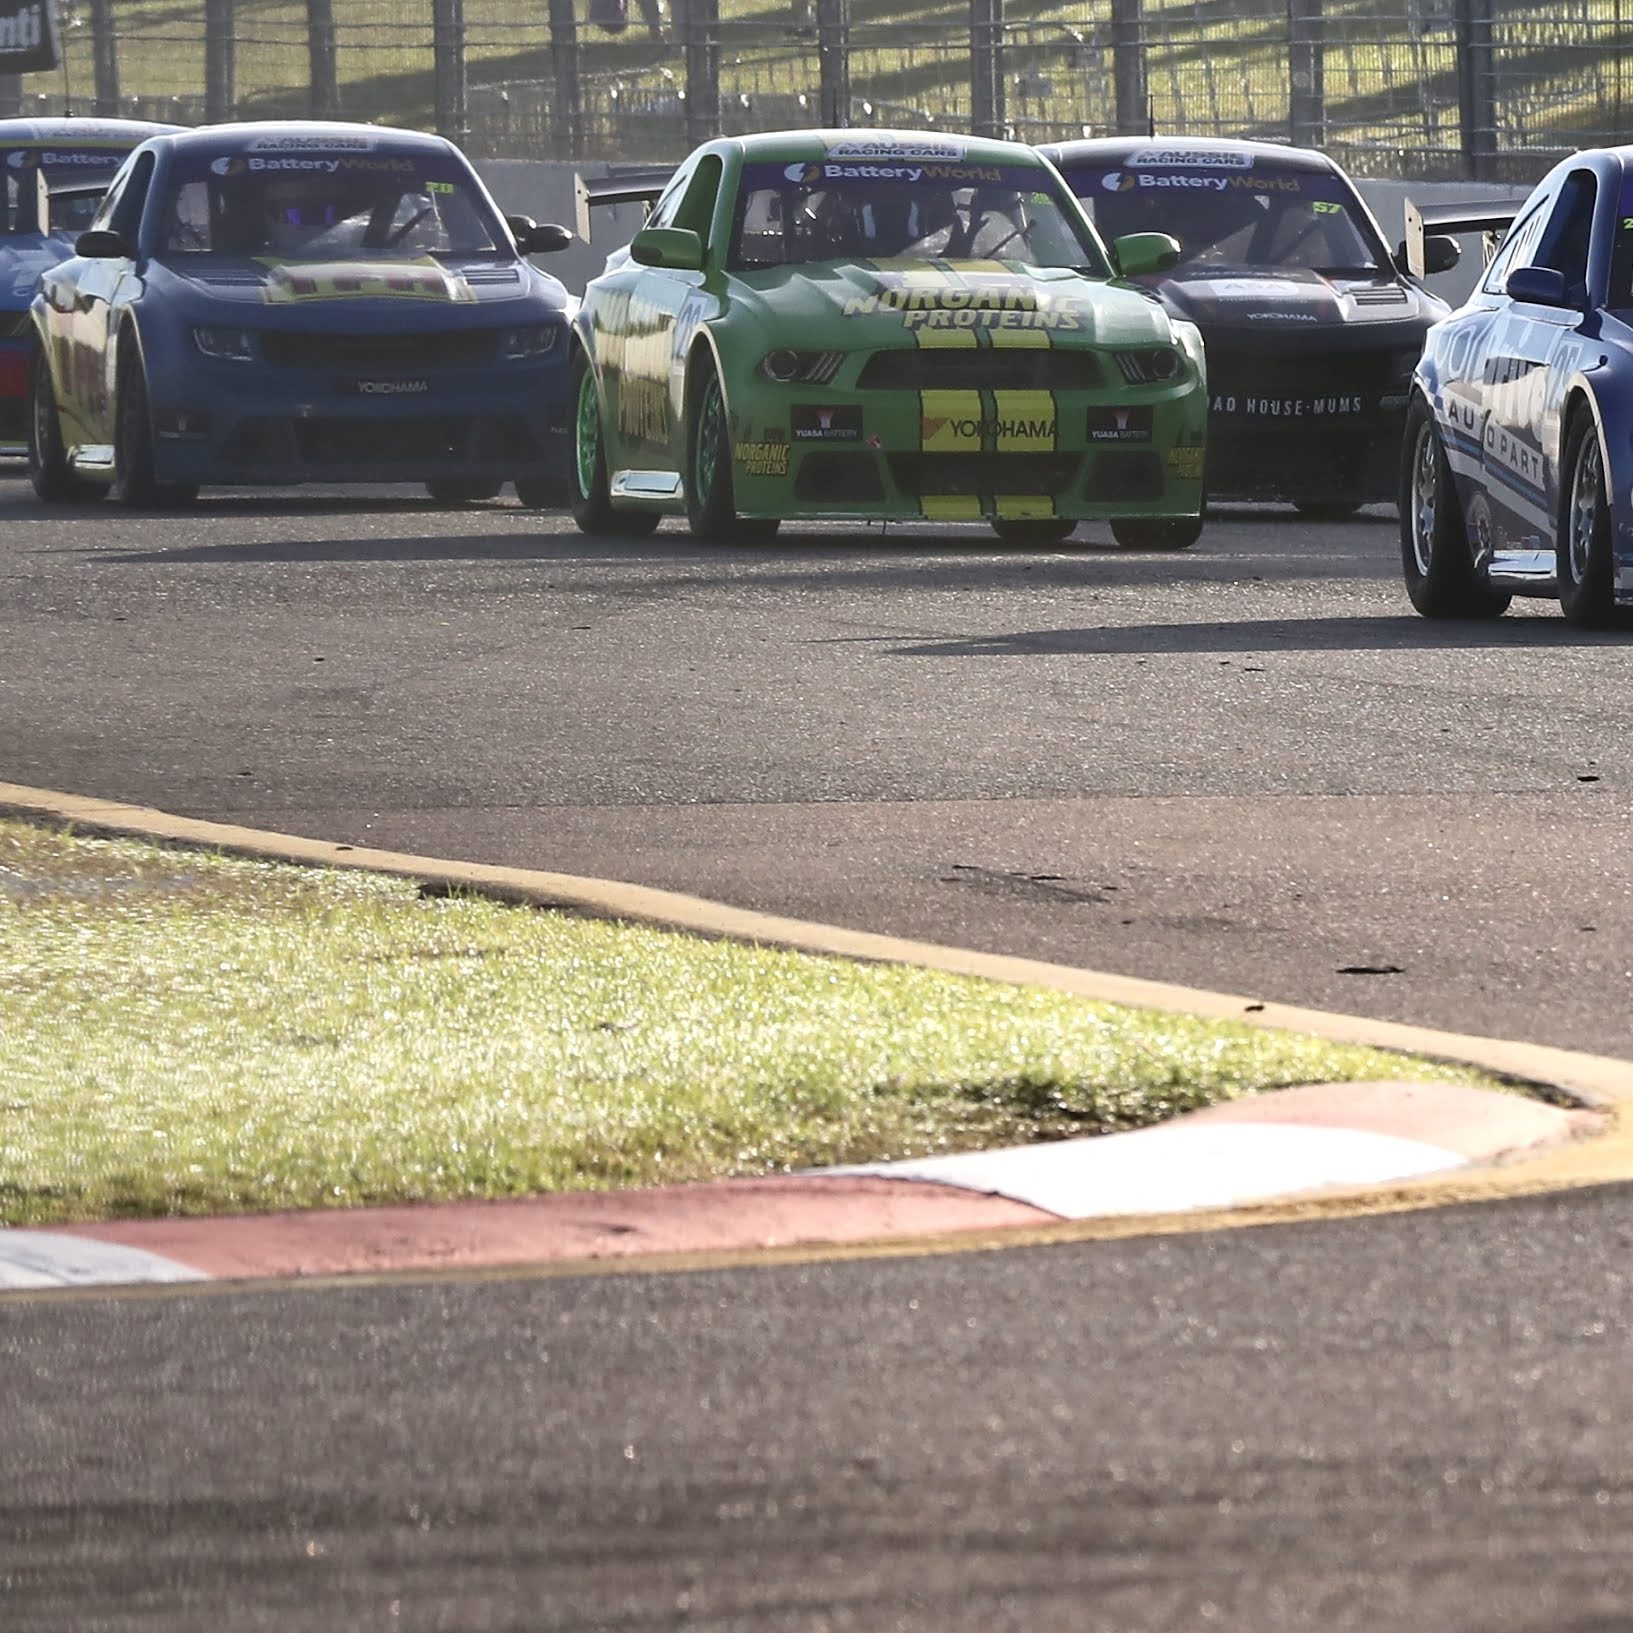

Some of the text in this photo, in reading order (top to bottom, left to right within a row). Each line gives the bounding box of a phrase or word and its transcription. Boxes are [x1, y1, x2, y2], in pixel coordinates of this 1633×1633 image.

[42, 152, 125, 167] Battery
[838, 148, 957, 157] RACING CARS
[1136, 157, 1246, 166] RACING CARS
[1140, 174, 1300, 191] BatteryWorld
[1313, 201, 1343, 214] 57
[903, 309, 1080, 330] PROTEINS
[1247, 312, 1318, 321] YOKOHAMA
[357, 380, 428, 394] YOKOHAMA
[795, 429, 822, 437] YUASA
[951, 420, 1059, 438] YOKOHAMA
[1092, 430, 1119, 439] YUASA
[735, 441, 790, 462] NORGANIC
[744, 460, 787, 475] PROTEINS
